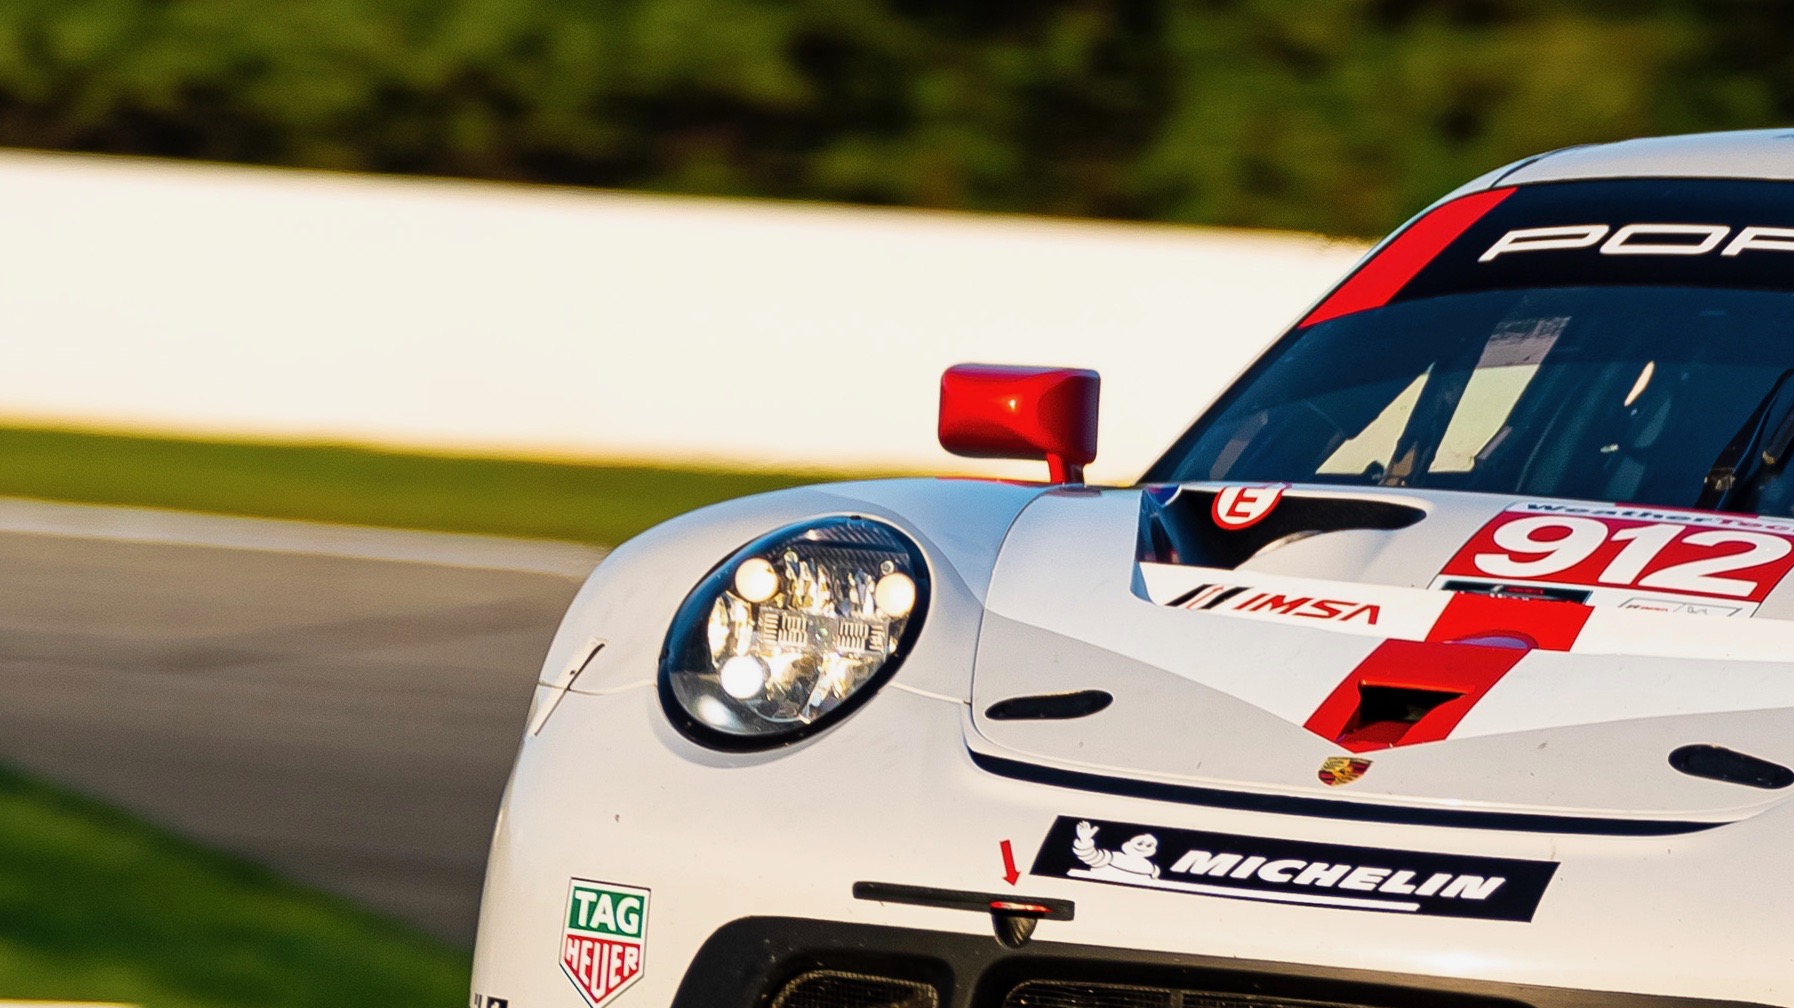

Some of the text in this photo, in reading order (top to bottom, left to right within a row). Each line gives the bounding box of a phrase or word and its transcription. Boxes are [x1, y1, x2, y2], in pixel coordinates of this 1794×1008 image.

[1474, 515, 1794, 597] 912
[1232, 592, 1381, 625] IMSA
[1170, 849, 1507, 901] MICHELIN
[574, 889, 641, 935] TAG
[564, 937, 639, 1000] HEUER
